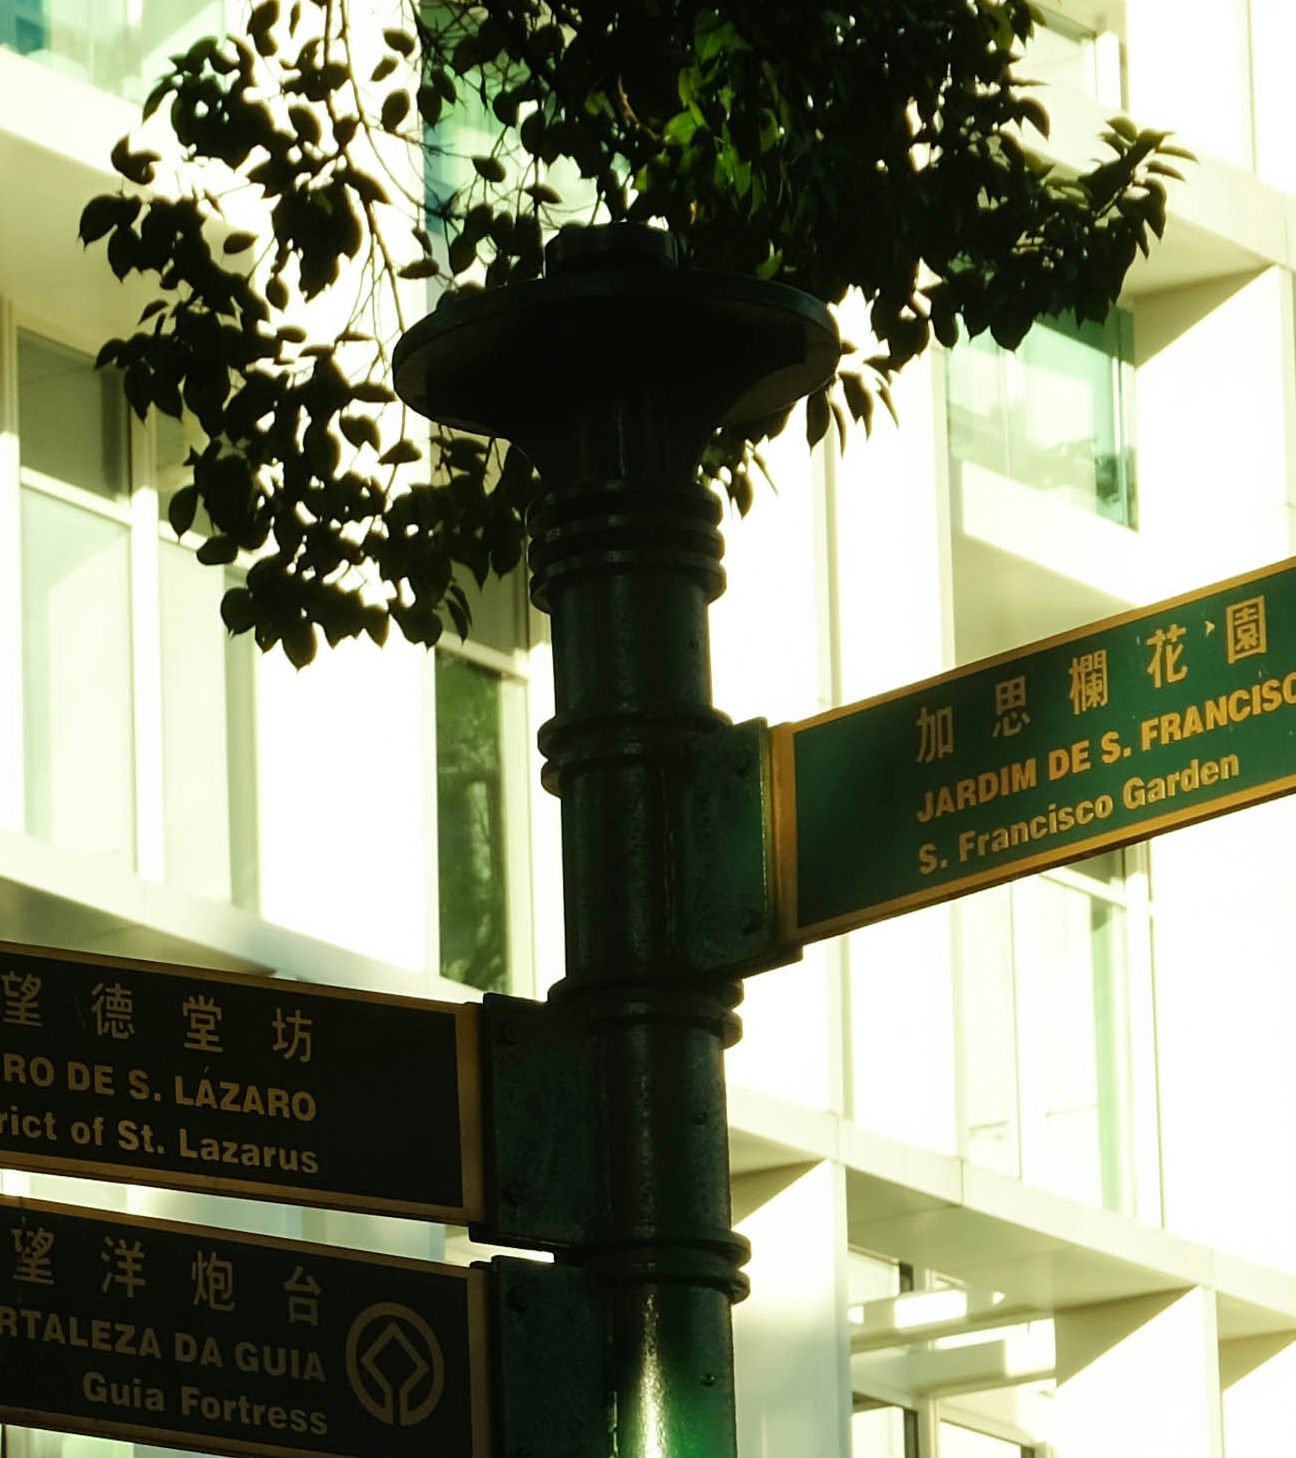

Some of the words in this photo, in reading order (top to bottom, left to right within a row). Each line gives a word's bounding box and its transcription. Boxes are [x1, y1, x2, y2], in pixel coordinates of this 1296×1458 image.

[916, 595, 1267, 764] 加思欄花園
[917, 758, 1037, 823] JARDIM
[1048, 739, 1091, 782] DE
[1101, 730, 1131, 765] S.
[918, 843, 948, 877] S.
[959, 793, 1113, 864] Francisco
[1123, 752, 1240, 811] Garden
[0, 970, 315, 1063] 望德堂坊
[67, 1061, 115, 1096] DE
[128, 1069, 162, 1103] S.
[174, 1065, 317, 1122] LÁZARO
[70, 1117, 104, 1146] of
[118, 1120, 165, 1155] St.
[179, 1128, 319, 1174] Lazarus
[174, 1333, 225, 1368] DA
[236, 1343, 327, 1383] GUIA
[83, 1371, 166, 1413] Guia
[181, 1387, 329, 1436] Fortress
